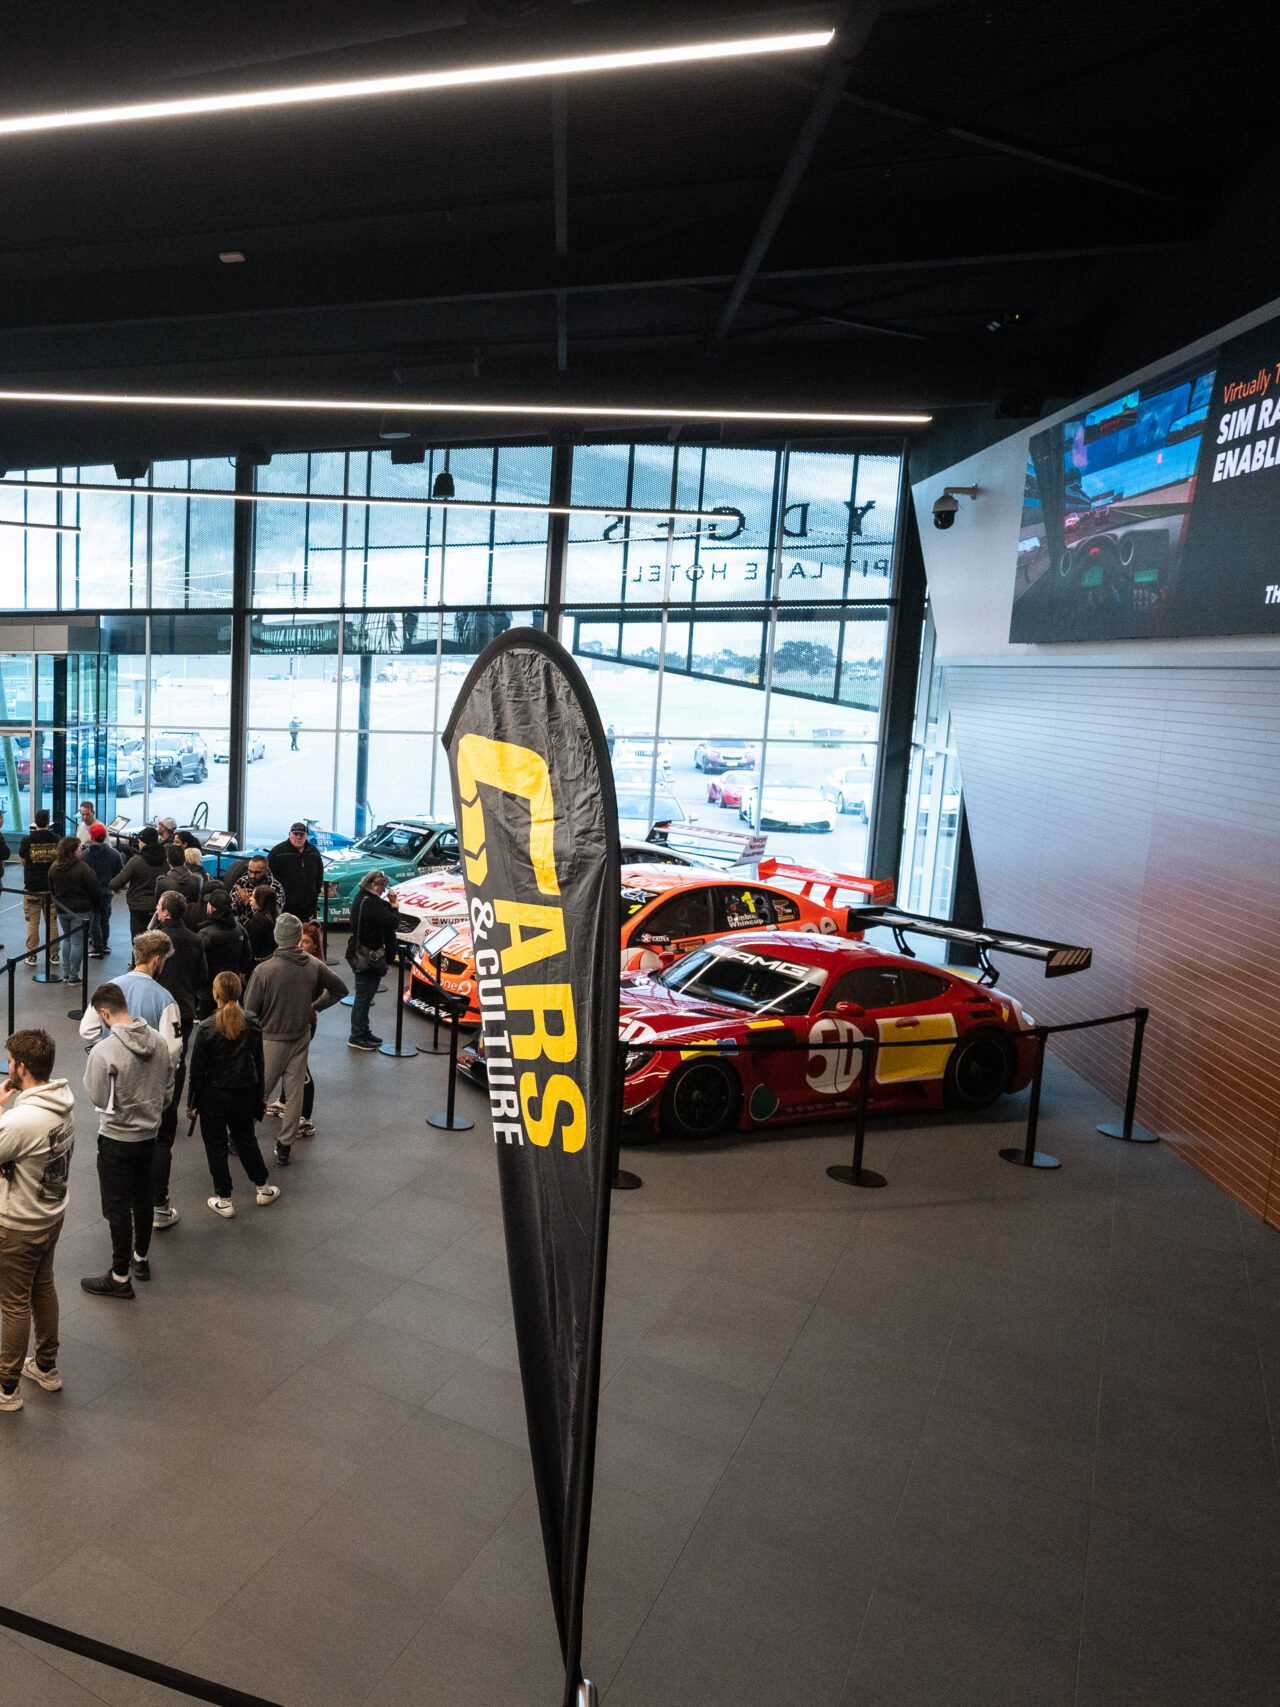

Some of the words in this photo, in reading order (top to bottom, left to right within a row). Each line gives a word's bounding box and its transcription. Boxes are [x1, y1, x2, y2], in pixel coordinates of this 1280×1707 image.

[1224, 369, 1272, 405] Virtually
[1216, 404, 1257, 445] SIM
[471, 897, 495, 940] &
[627, 904, 643, 915] 1
[741, 891, 756, 912] 1
[729, 918, 763, 928] Whincup
[457, 733, 587, 1154] CARS
[729, 951, 810, 977] AMG
[476, 948, 525, 1146] CULTURE
